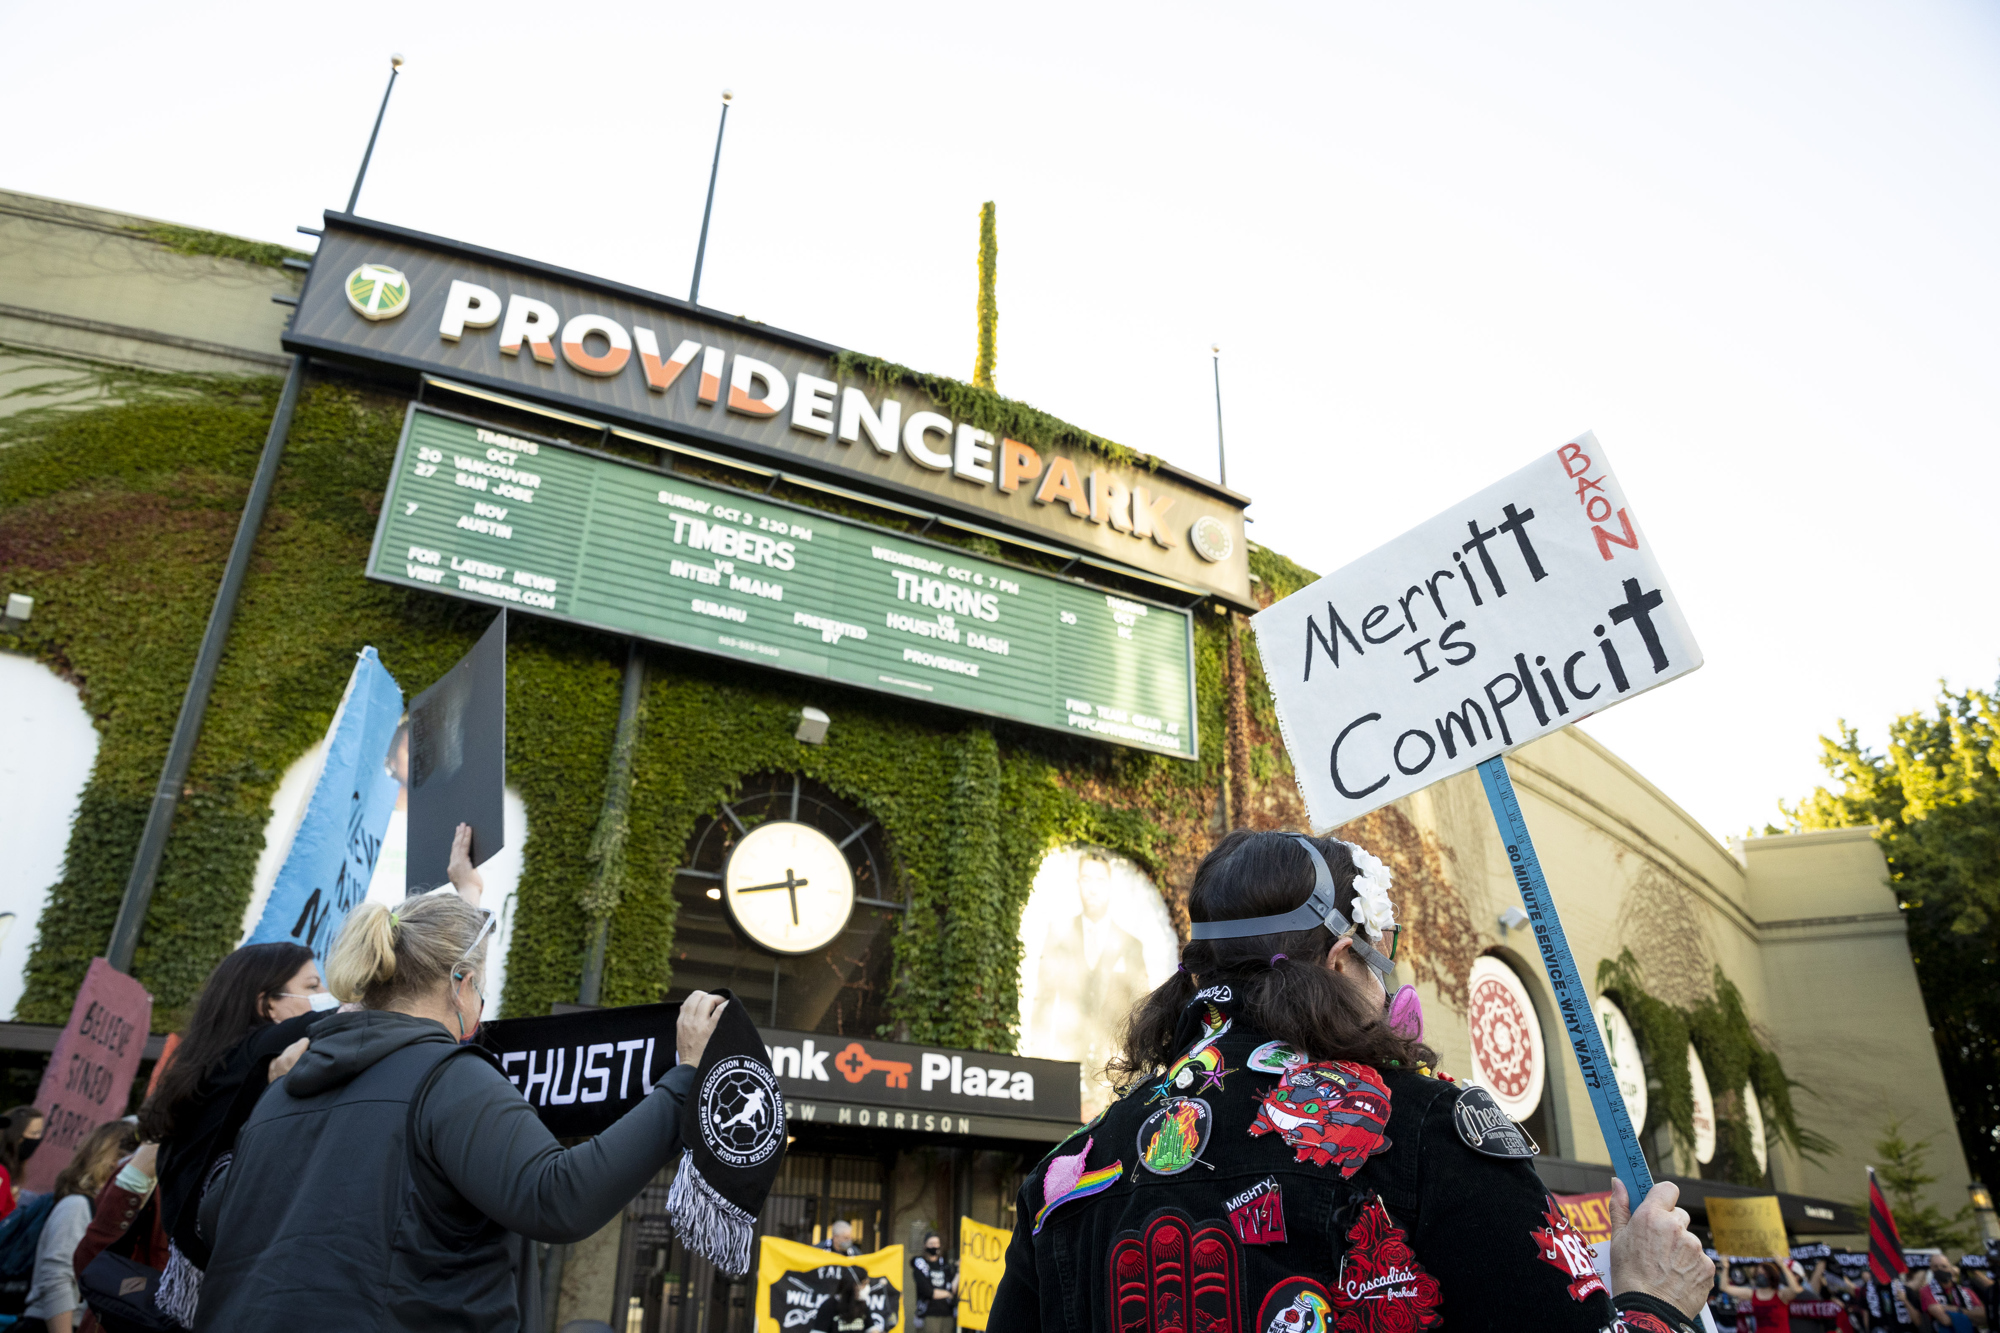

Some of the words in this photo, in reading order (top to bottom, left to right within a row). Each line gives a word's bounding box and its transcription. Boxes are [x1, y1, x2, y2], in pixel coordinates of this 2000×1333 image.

[439, 279, 995, 487] PROVIDENCE
[999, 438, 1177, 549] PARK
[476, 428, 539, 455] TIMBERS
[486, 448, 518, 466] OCT
[413, 462, 437, 478] 27
[455, 472, 488, 491] SAN
[492, 483, 534, 503] JOSE
[417, 446, 442, 463] 20
[454, 455, 541, 489] VANCOUVER
[405, 502, 419, 516] 7
[456, 515, 513, 539] AUSTIN
[473, 501, 508, 521] NOV
[658, 491, 712, 515] SUNDAY
[712, 505, 741, 523] OCT
[742, 514, 753, 525] 3
[790, 525, 812, 541] PM
[669, 513, 796, 571] TIMBERS
[406, 563, 445, 584] VISIT
[457, 575, 556, 610] TIMBERS.COM
[407, 546, 441, 566] FOR
[450, 556, 506, 580] LATEST
[512, 570, 557, 592] NEWS
[669, 559, 721, 586] INTER
[729, 574, 783, 601] MIAMI
[714, 558, 735, 575] VS
[871, 545, 944, 575] WEDNESDAY
[947, 566, 971, 582] OCT
[973, 573, 983, 585] 6
[989, 577, 998, 588] 7
[999, 580, 1019, 595] PM
[691, 599, 747, 623] SUBARU
[891, 569, 1000, 622] THORNS
[1303, 503, 1548, 683] Merritt
[793, 612, 868, 640] PRESENTED
[822, 631, 841, 644] BY
[886, 612, 960, 644] HOUSTON
[967, 632, 1009, 655] DASH
[937, 614, 955, 628] VS
[1060, 610, 1077, 625] 30
[903, 648, 979, 677] PROVIDENCE
[1330, 577, 1669, 800] Complicit
[1507, 844, 1521, 862] 60
[1514, 864, 1543, 921] MINUTE
[1574, 1038, 1601, 1090] WAIT?
[493, 1037, 680, 1107] EHUSTL
[702, 1060, 740, 1101] ASSOCIATION
[743, 1060, 776, 1090] NATIONAL
[920, 1052, 1034, 1102] Plaza
[701, 1105, 716, 1146] PLAYERS
[774, 1091, 784, 1135] WOMEN'S
[785, 1102, 817, 1121] SW
[838, 1107, 970, 1134] MORRISON
[716, 1147, 747, 1164] LEAGUE
[749, 1138, 777, 1163] SOCCER
[1226, 1178, 1271, 1212] MIGHTY
[961, 1229, 1002, 1262] HOLD
[1346, 1266, 1417, 1300] Cascadia's
